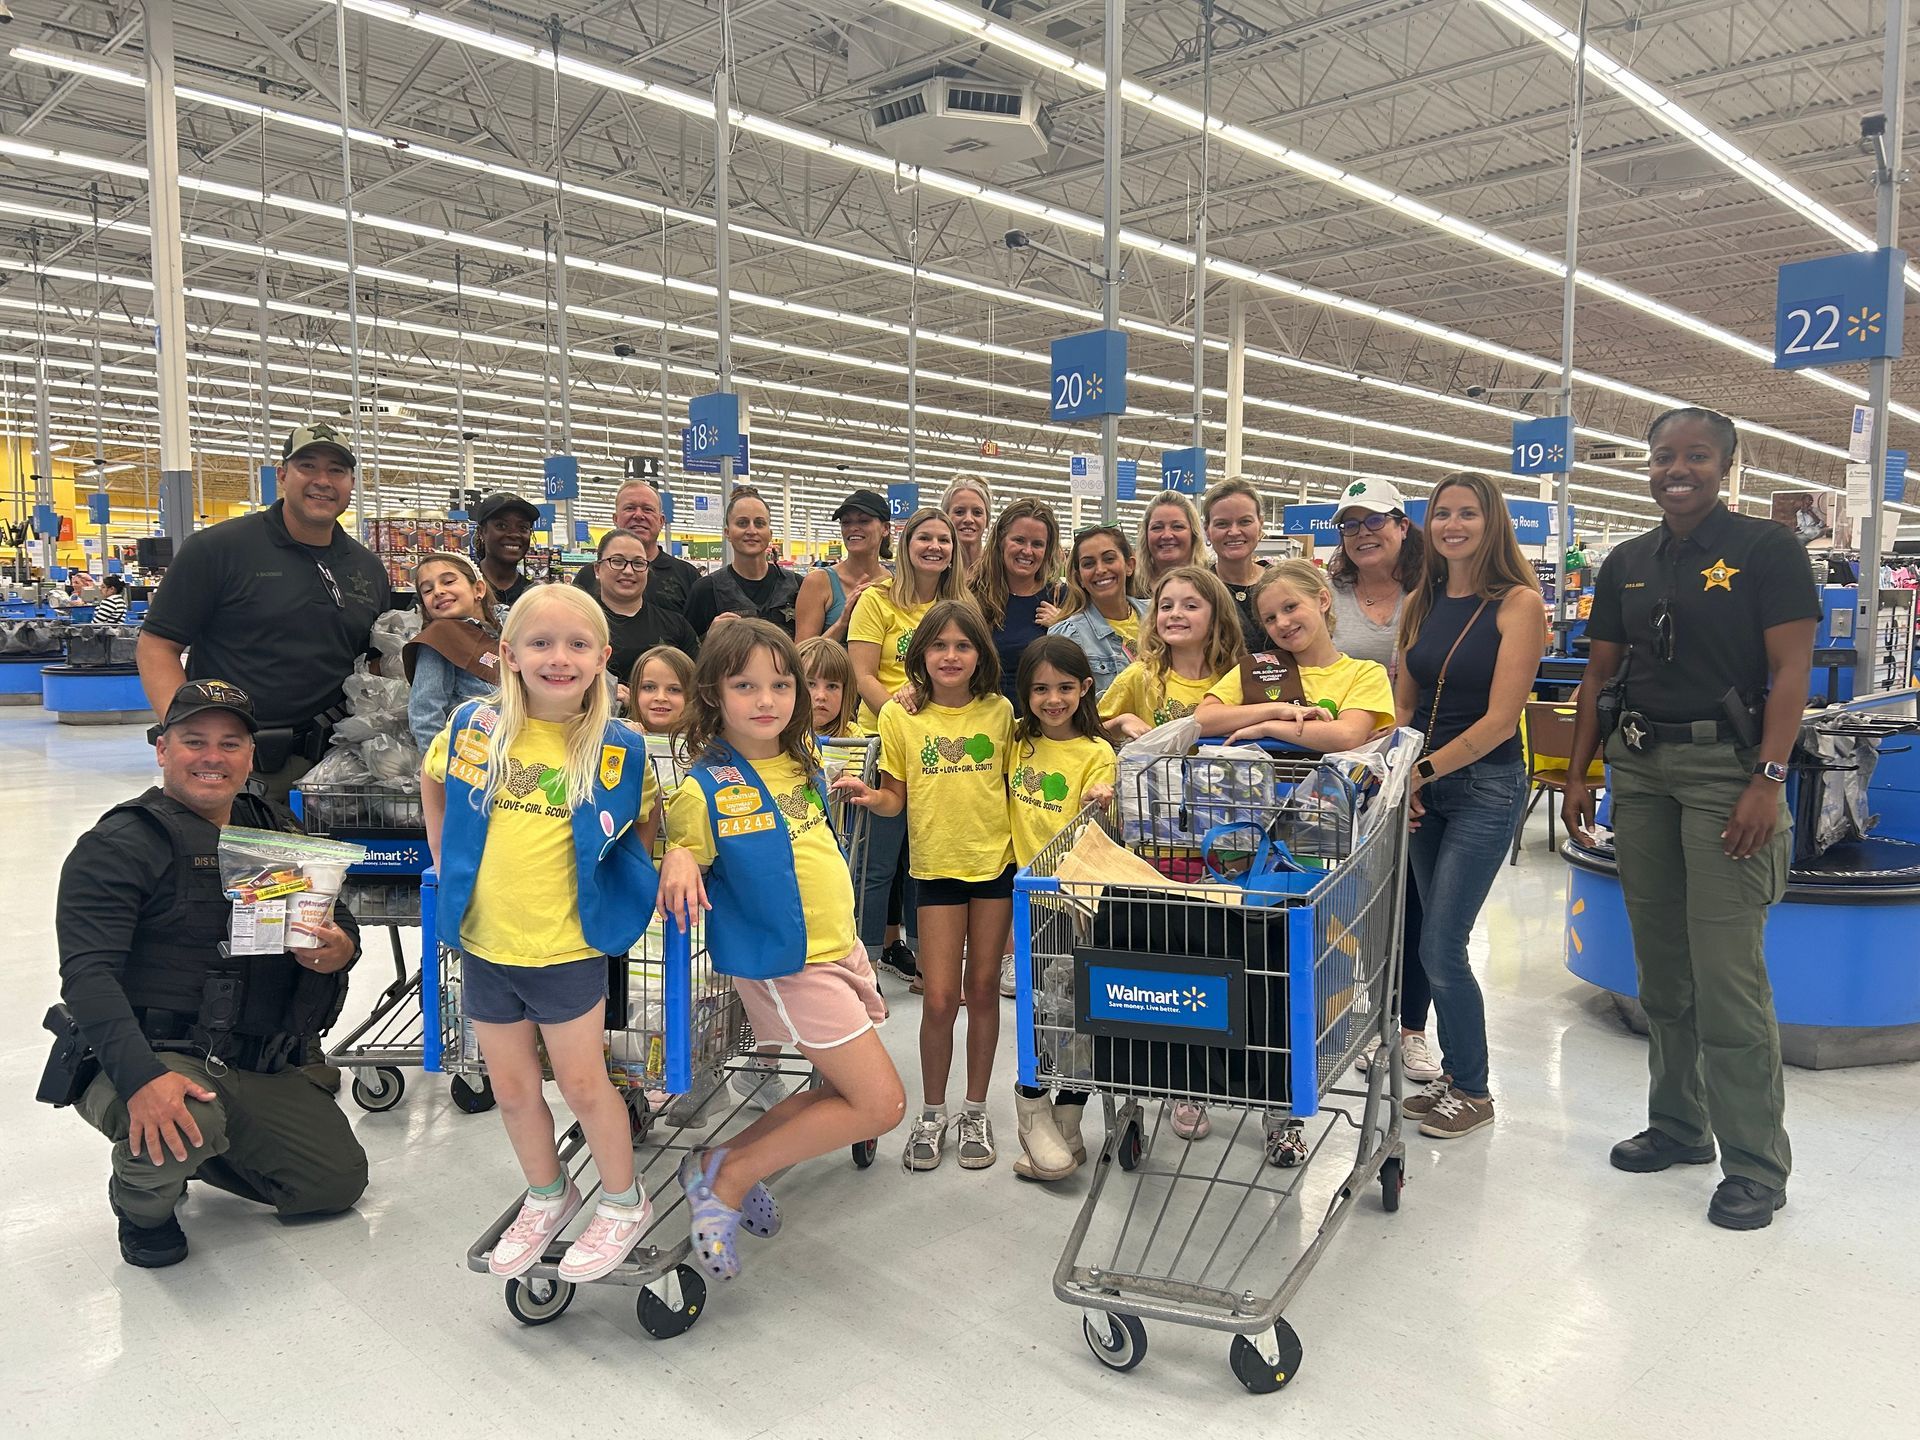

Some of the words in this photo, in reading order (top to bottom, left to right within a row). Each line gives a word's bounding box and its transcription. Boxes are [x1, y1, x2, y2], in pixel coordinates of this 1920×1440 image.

[1784, 305, 1840, 354] 22
[1055, 372, 1083, 410] 20
[691, 423, 708, 451] 18
[985, 442, 996, 455] EXIT
[1516, 443, 1544, 468] 19
[545, 476, 557, 495] 16
[1164, 469, 1182, 490] 17
[889, 499, 901, 515] 15
[1520, 515, 1539, 528] Rooms
[922, 767, 939, 775] PEACE
[944, 765, 958, 774] LOVE
[961, 764, 974, 773] GIRL
[975, 763, 993, 771] SCOUTS
[498, 799, 520, 811] LOVE
[525, 803, 542, 814] GIRL
[545, 806, 570, 819] SCOUT
[1019, 794, 1033, 804] LOVE
[1043, 802, 1063, 813] SCOUTS
[720, 815, 773, 834] 24245
[364, 850, 401, 861] almart
[1106, 983, 1179, 1005] Walmart
[1109, 1001, 1123, 1009] Save
[1123, 1002, 1145, 1011] money.
